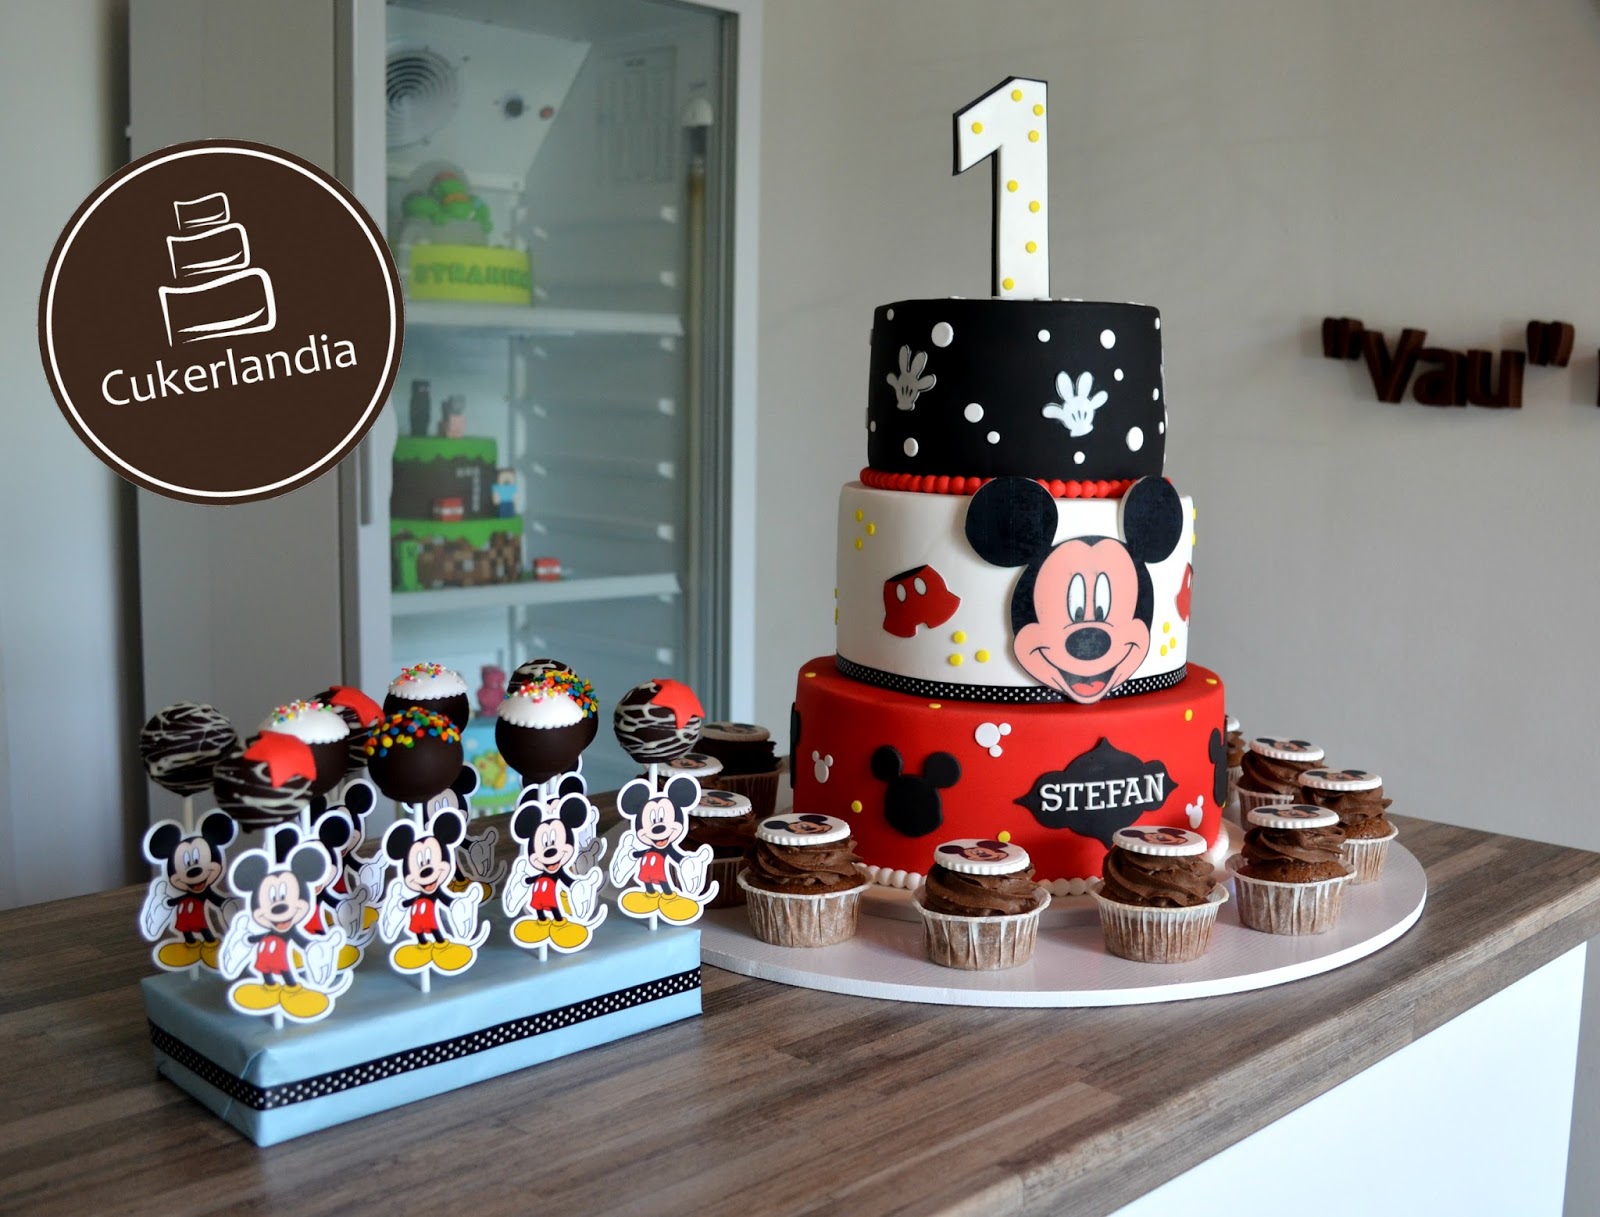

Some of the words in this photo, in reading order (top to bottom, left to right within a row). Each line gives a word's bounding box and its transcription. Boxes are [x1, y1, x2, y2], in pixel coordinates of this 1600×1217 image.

[953, 76, 1049, 298] 1
[1321, 317, 1575, 409] "Vau"
[1039, 772, 1165, 812] STEFAN
